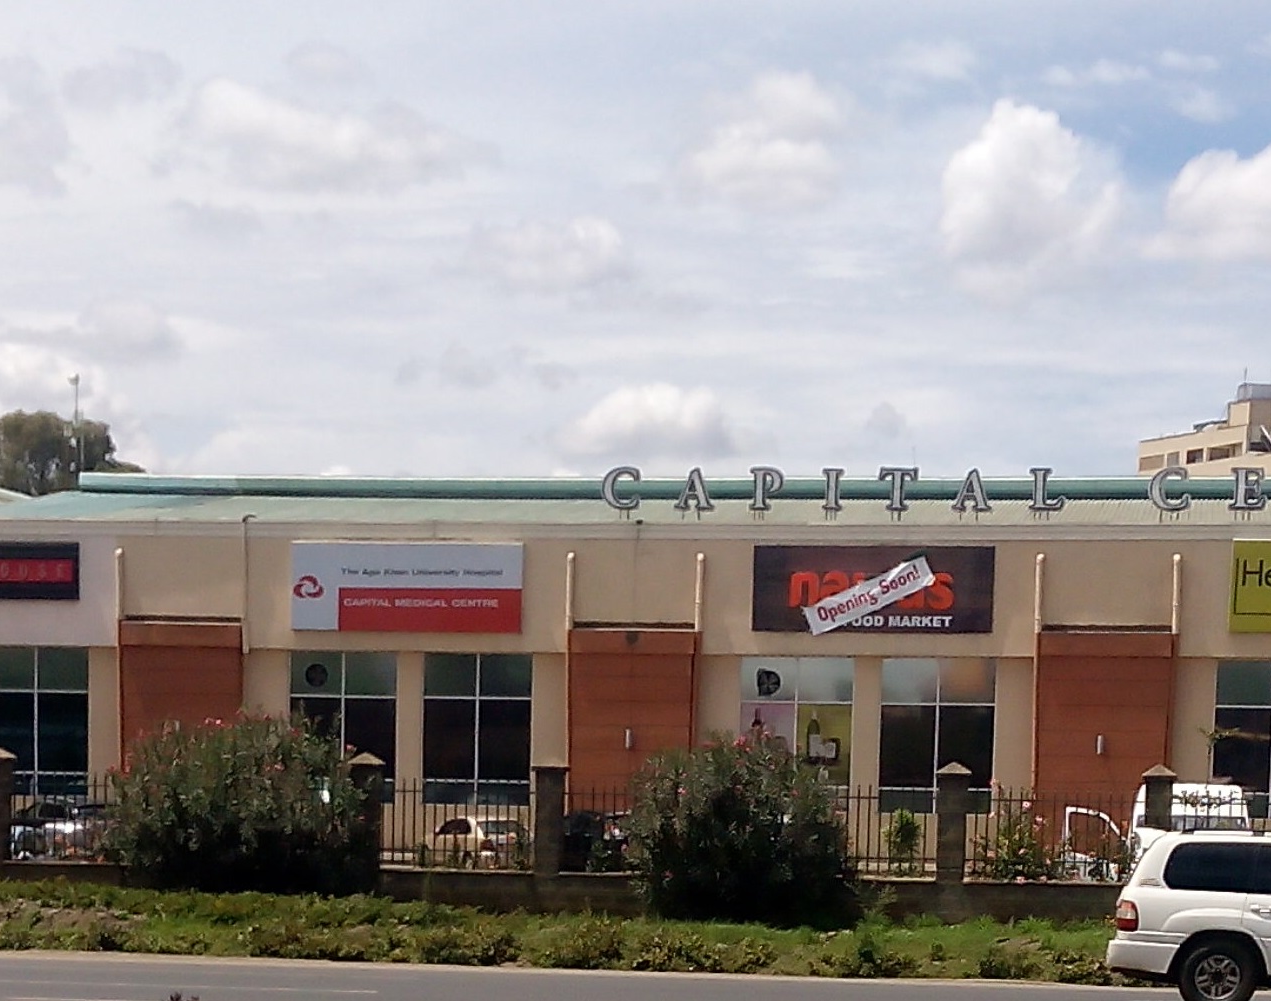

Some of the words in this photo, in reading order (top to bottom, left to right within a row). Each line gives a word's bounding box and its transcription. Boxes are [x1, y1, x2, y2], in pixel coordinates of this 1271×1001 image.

[601, 466, 1066, 512] CAPITAL
[343, 598, 392, 608] CAPITAL
[395, 598, 448, 608] MEDICAL
[452, 598, 499, 608] CENTRE
[788, 571, 955, 610] nas
[817, 592, 879, 623] Opening
[879, 565, 921, 595] Soon!
[844, 615, 884, 627] OOD
[888, 615, 953, 628] MARKET
